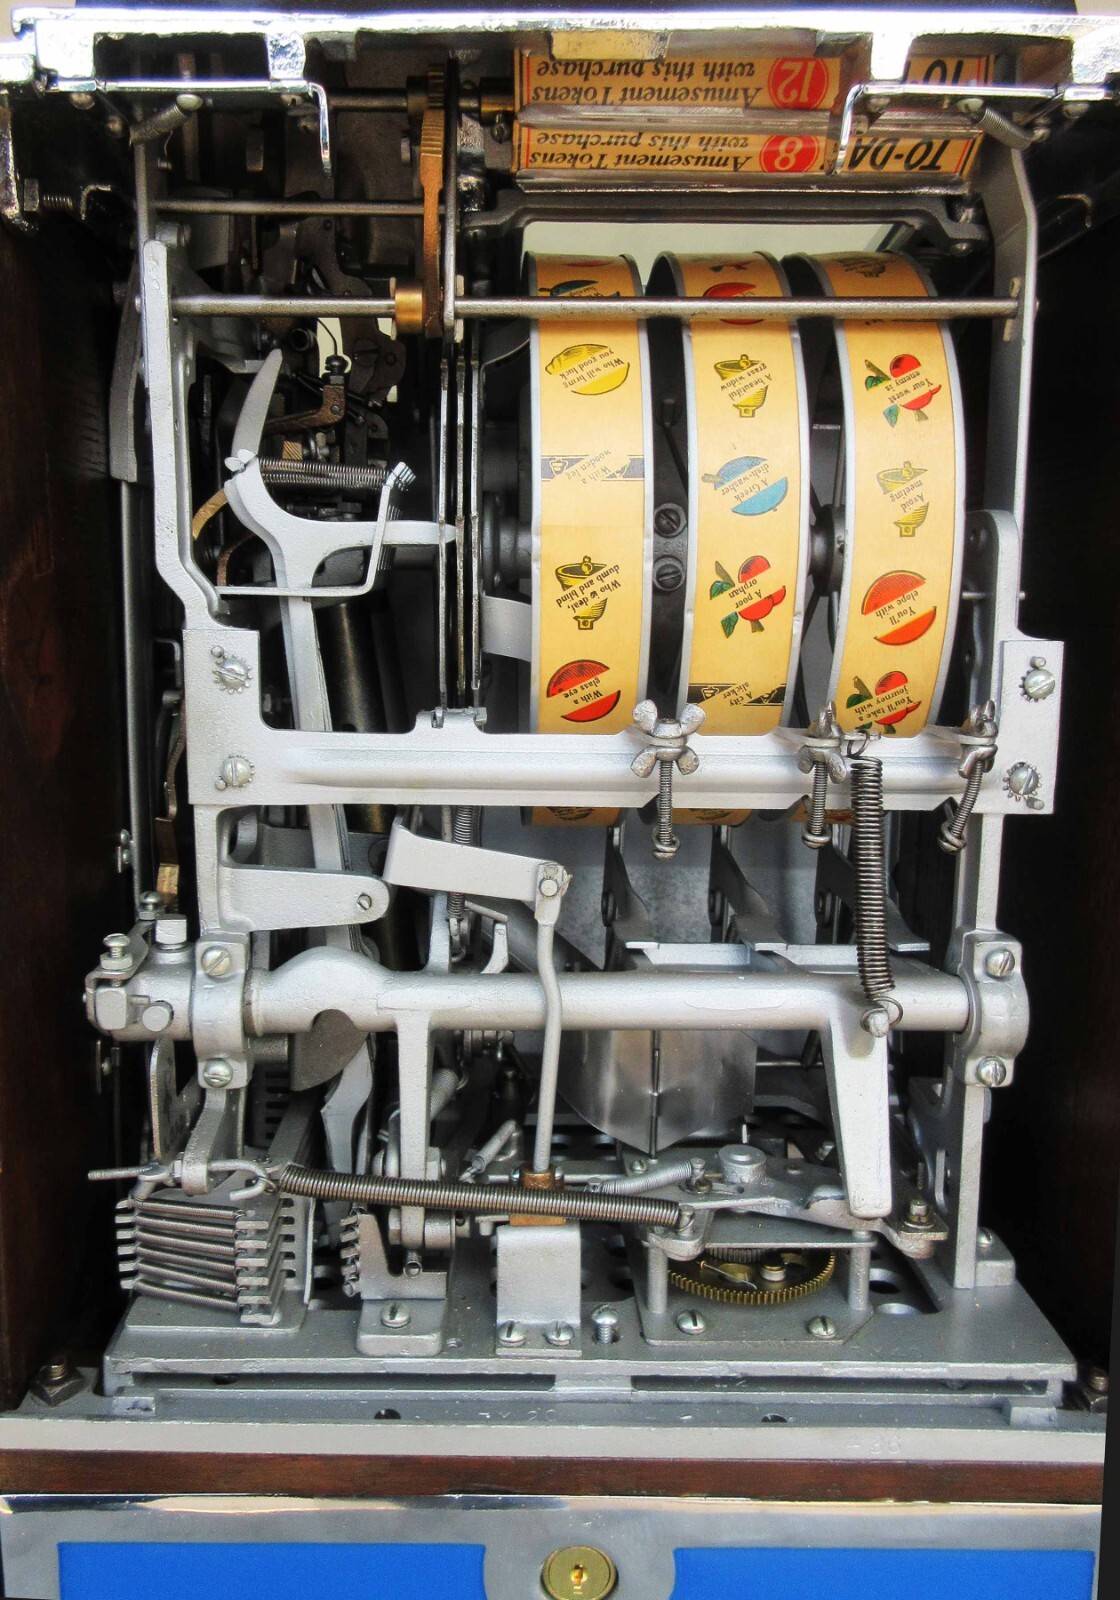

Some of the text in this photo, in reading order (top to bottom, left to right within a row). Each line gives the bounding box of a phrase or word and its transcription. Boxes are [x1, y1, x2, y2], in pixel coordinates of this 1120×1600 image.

[536, 60, 755, 82] with this purchase
[776, 61, 816, 104] 12
[531, 86, 762, 109] Amusement Tokens
[536, 132, 749, 152] with this purchase
[529, 152, 752, 172] Amusement Tokens
[774, 136, 803, 171] 8
[822, 138, 950, 171] TO-DA
[559, 348, 614, 380] you good luck
[562, 358, 624, 388] Who will bring
[720, 363, 767, 391] grass widow
[728, 373, 772, 401] A beautiful
[884, 371, 920, 392] enemy is
[888, 378, 933, 404] Your worst
[565, 469, 581, 480] leg
[720, 463, 769, 496] dish-washer
[734, 478, 768, 502] A Greek
[889, 480, 923, 502] meeting
[900, 492, 924, 513] Avoid
[556, 564, 620, 608] dumb and blind
[600, 580, 620, 592] Who
[728, 578, 758, 600] orphan
[567, 596, 588, 613] deaf,
[734, 589, 762, 609] A poor
[875, 590, 918, 619] elope with
[889, 606, 916, 625] You'll
[563, 678, 600, 698] glass eye
[580, 690, 602, 702] With
[722, 682, 750, 699] slicker
[730, 696, 744, 706] city
[854, 686, 908, 714] journey with
[887, 696, 913, 712] You'll
[866, 706, 885, 718] take
